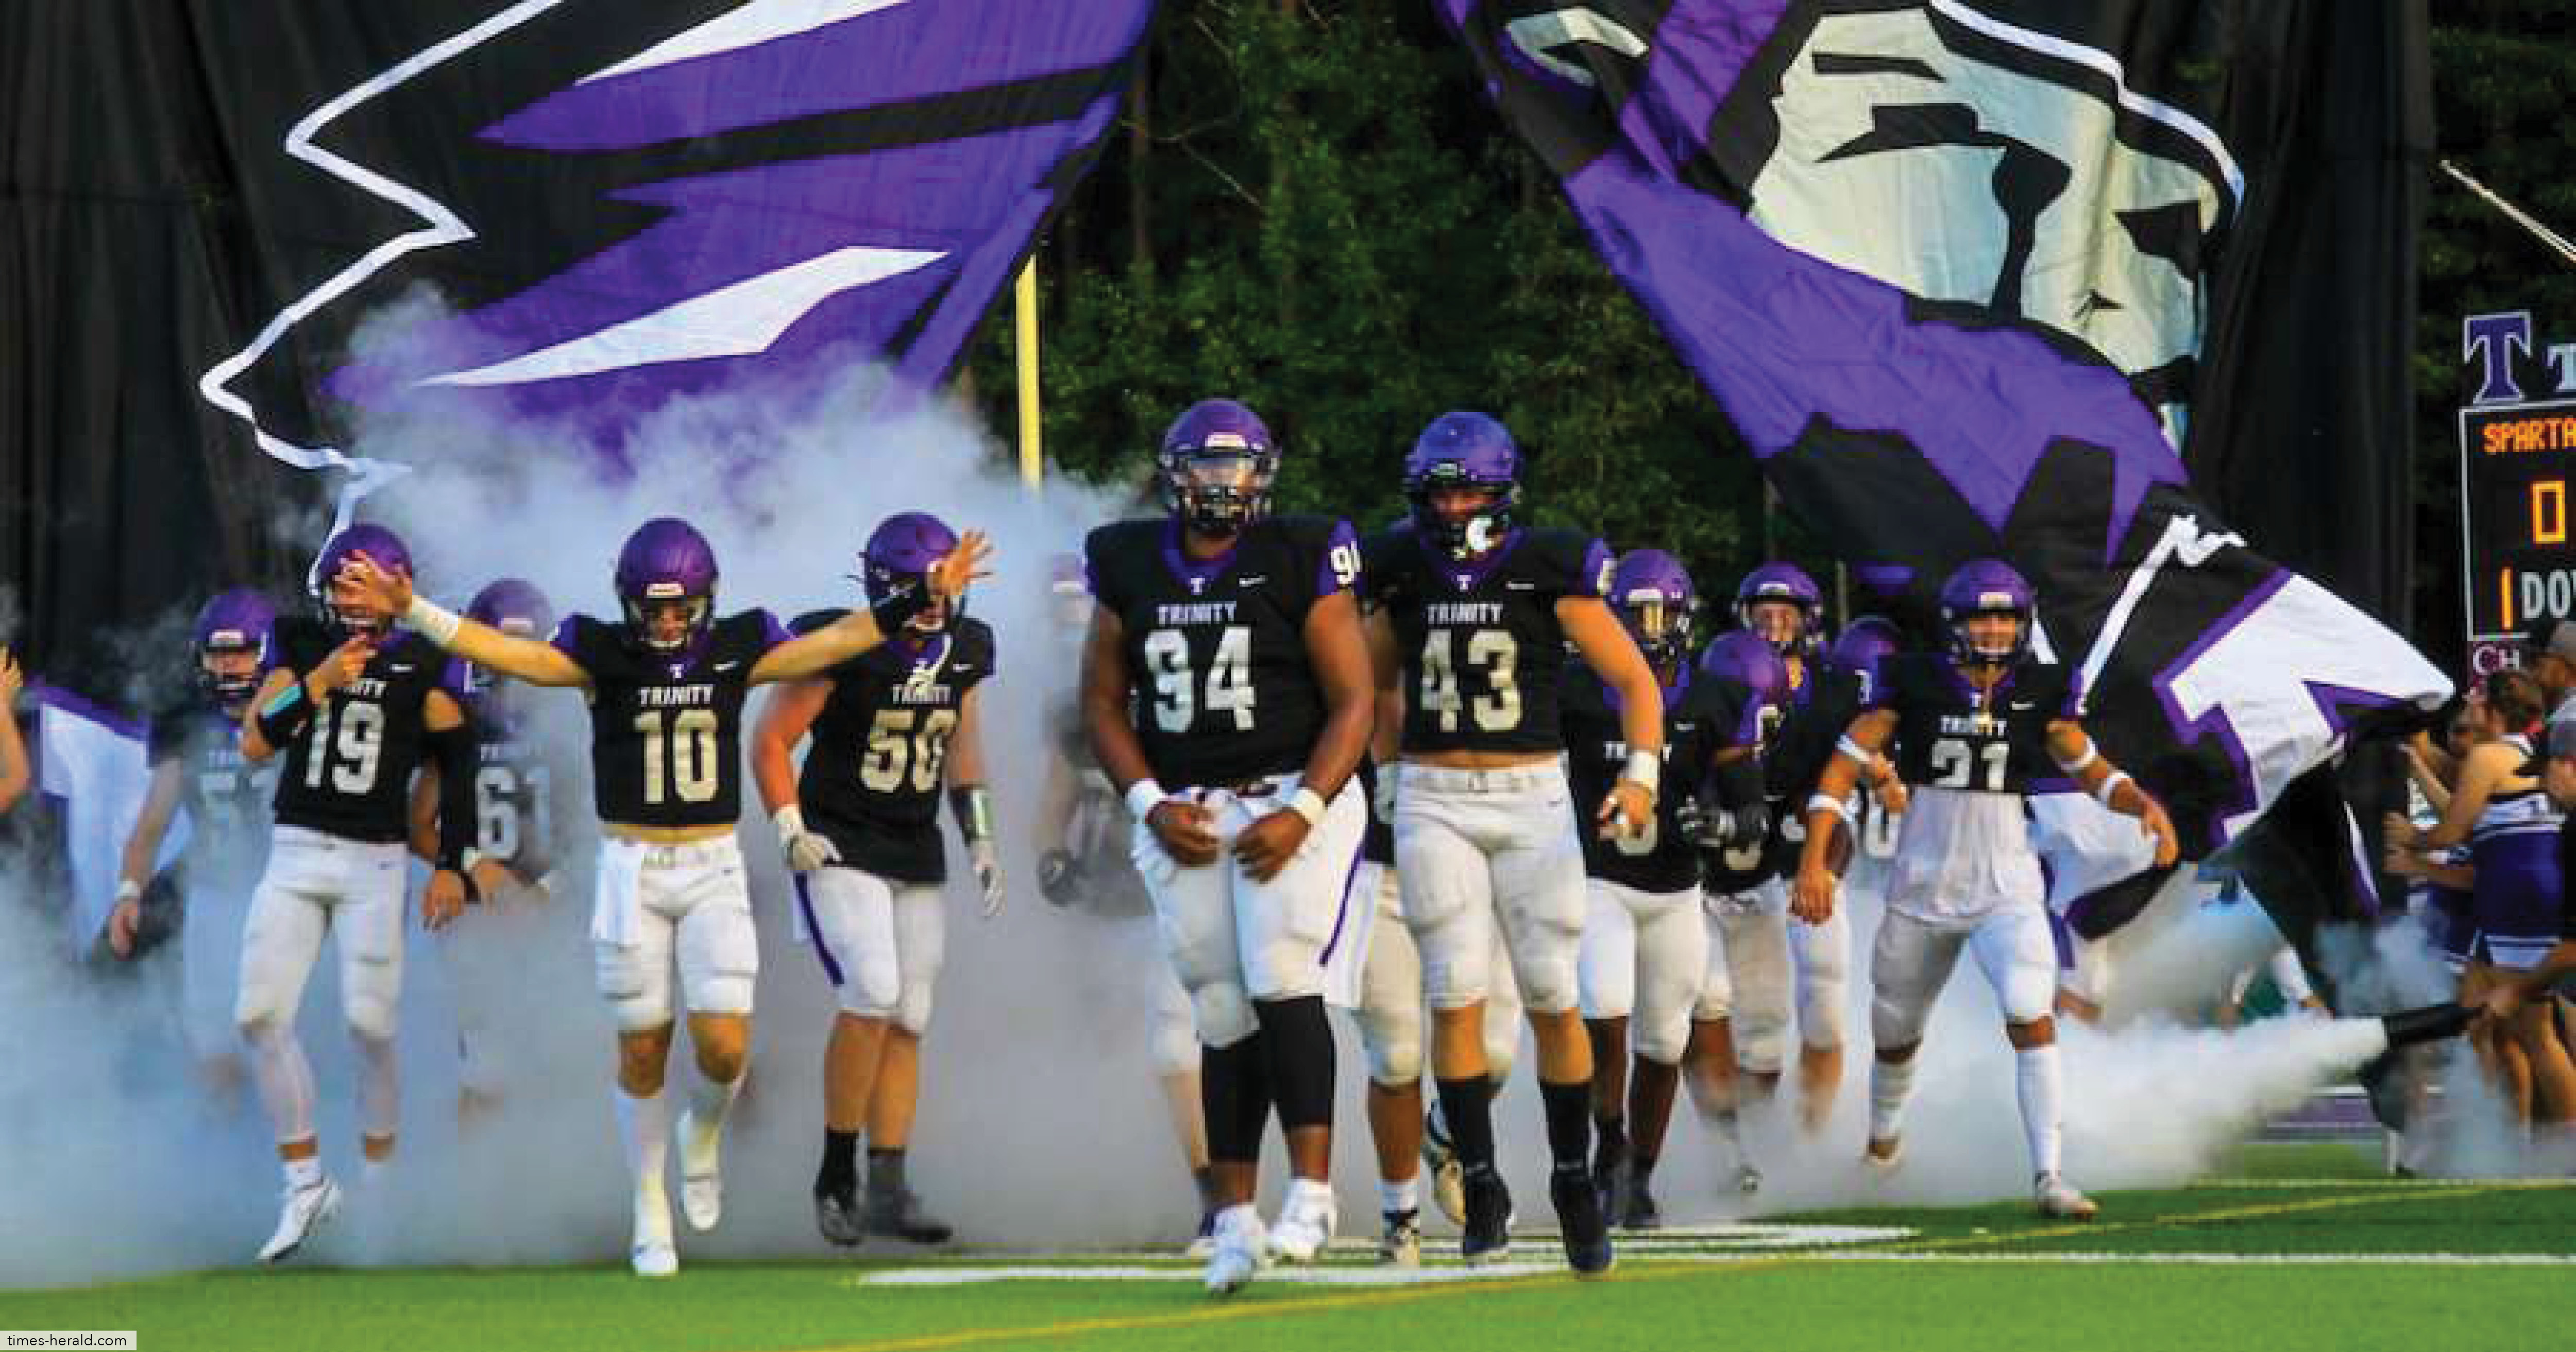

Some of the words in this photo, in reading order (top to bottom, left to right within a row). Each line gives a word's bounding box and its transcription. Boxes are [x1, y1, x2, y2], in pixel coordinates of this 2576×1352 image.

[2464, 312, 2531, 403] T
[1157, 602, 1236, 625] TRINITY
[1427, 603, 1503, 624] TRINITY
[2521, 571, 2576, 619] DO
[639, 686, 713, 705] TRINITY
[1144, 626, 1257, 733] 94
[1421, 629, 1522, 732] 43
[306, 700, 385, 793] 19
[635, 709, 719, 803] 10
[475, 766, 550, 860] 61
